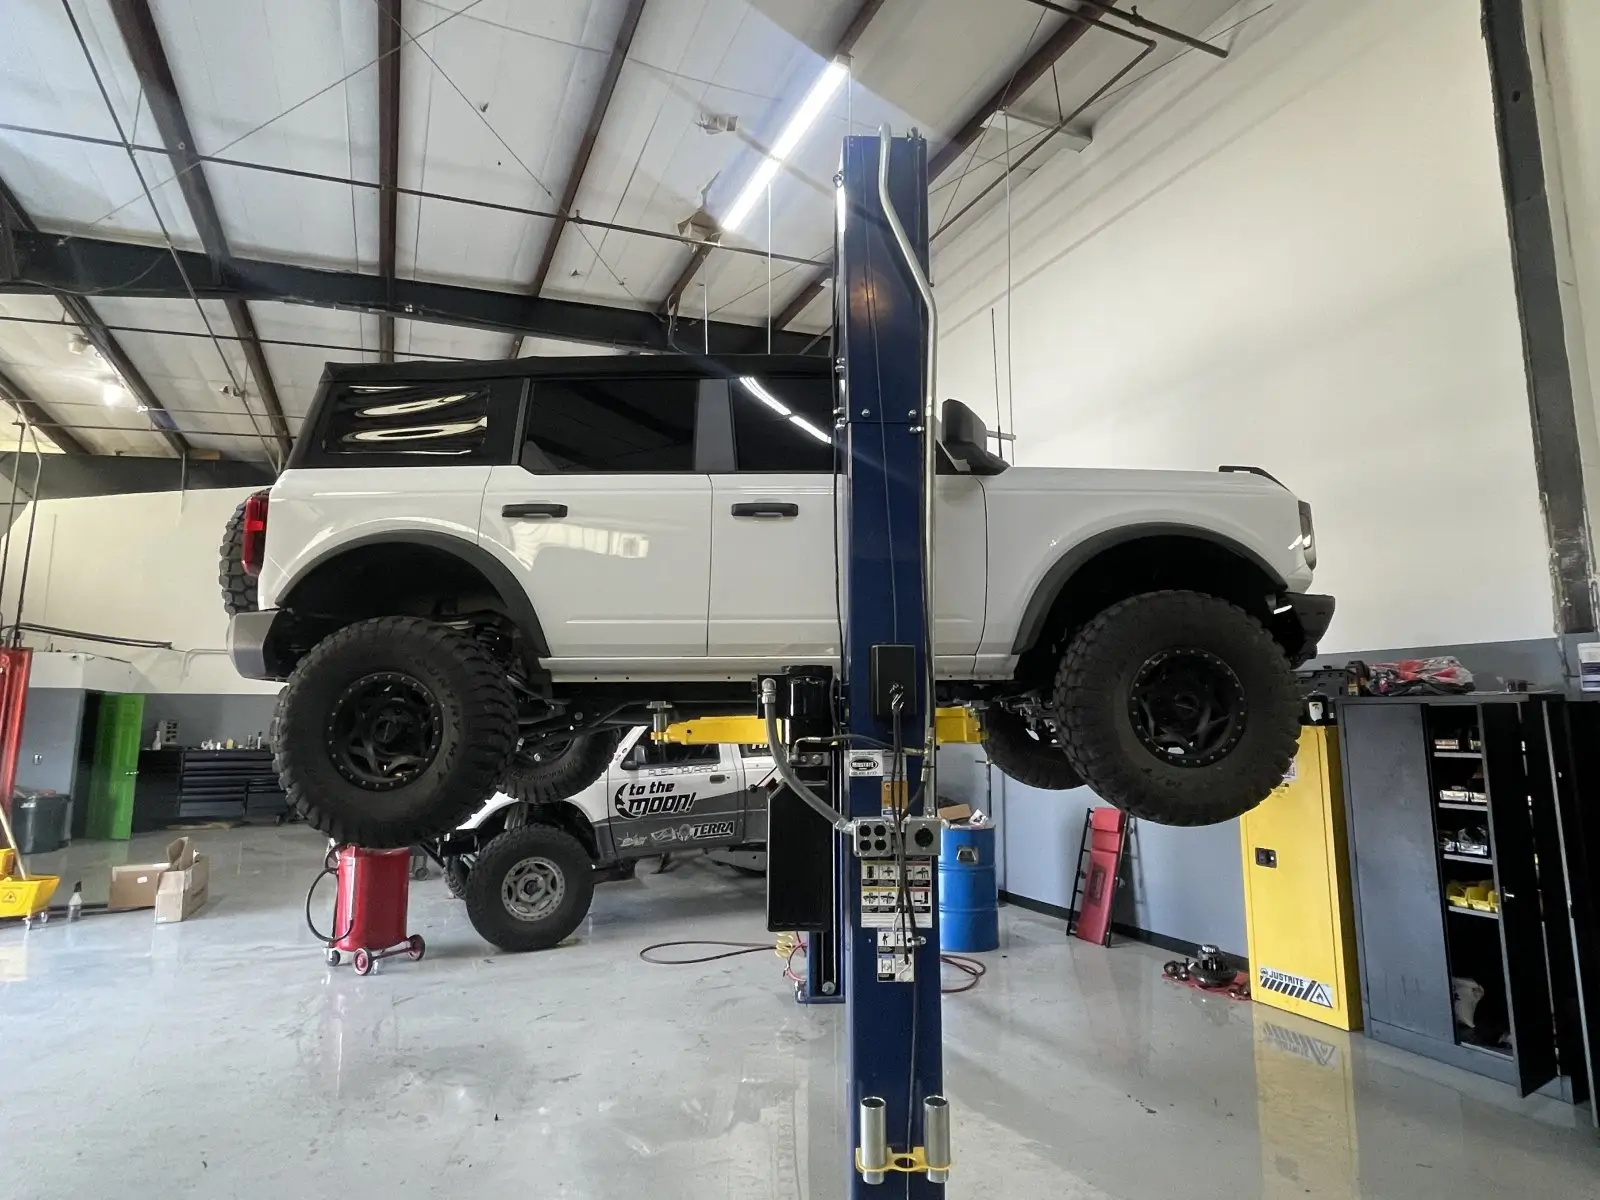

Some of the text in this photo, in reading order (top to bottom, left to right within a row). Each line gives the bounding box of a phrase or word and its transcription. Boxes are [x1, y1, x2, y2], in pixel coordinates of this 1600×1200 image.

[629, 781, 675, 796] to the
[693, 821, 734, 837] TERRA
[1269, 971, 1304, 987] JUSTRITE
